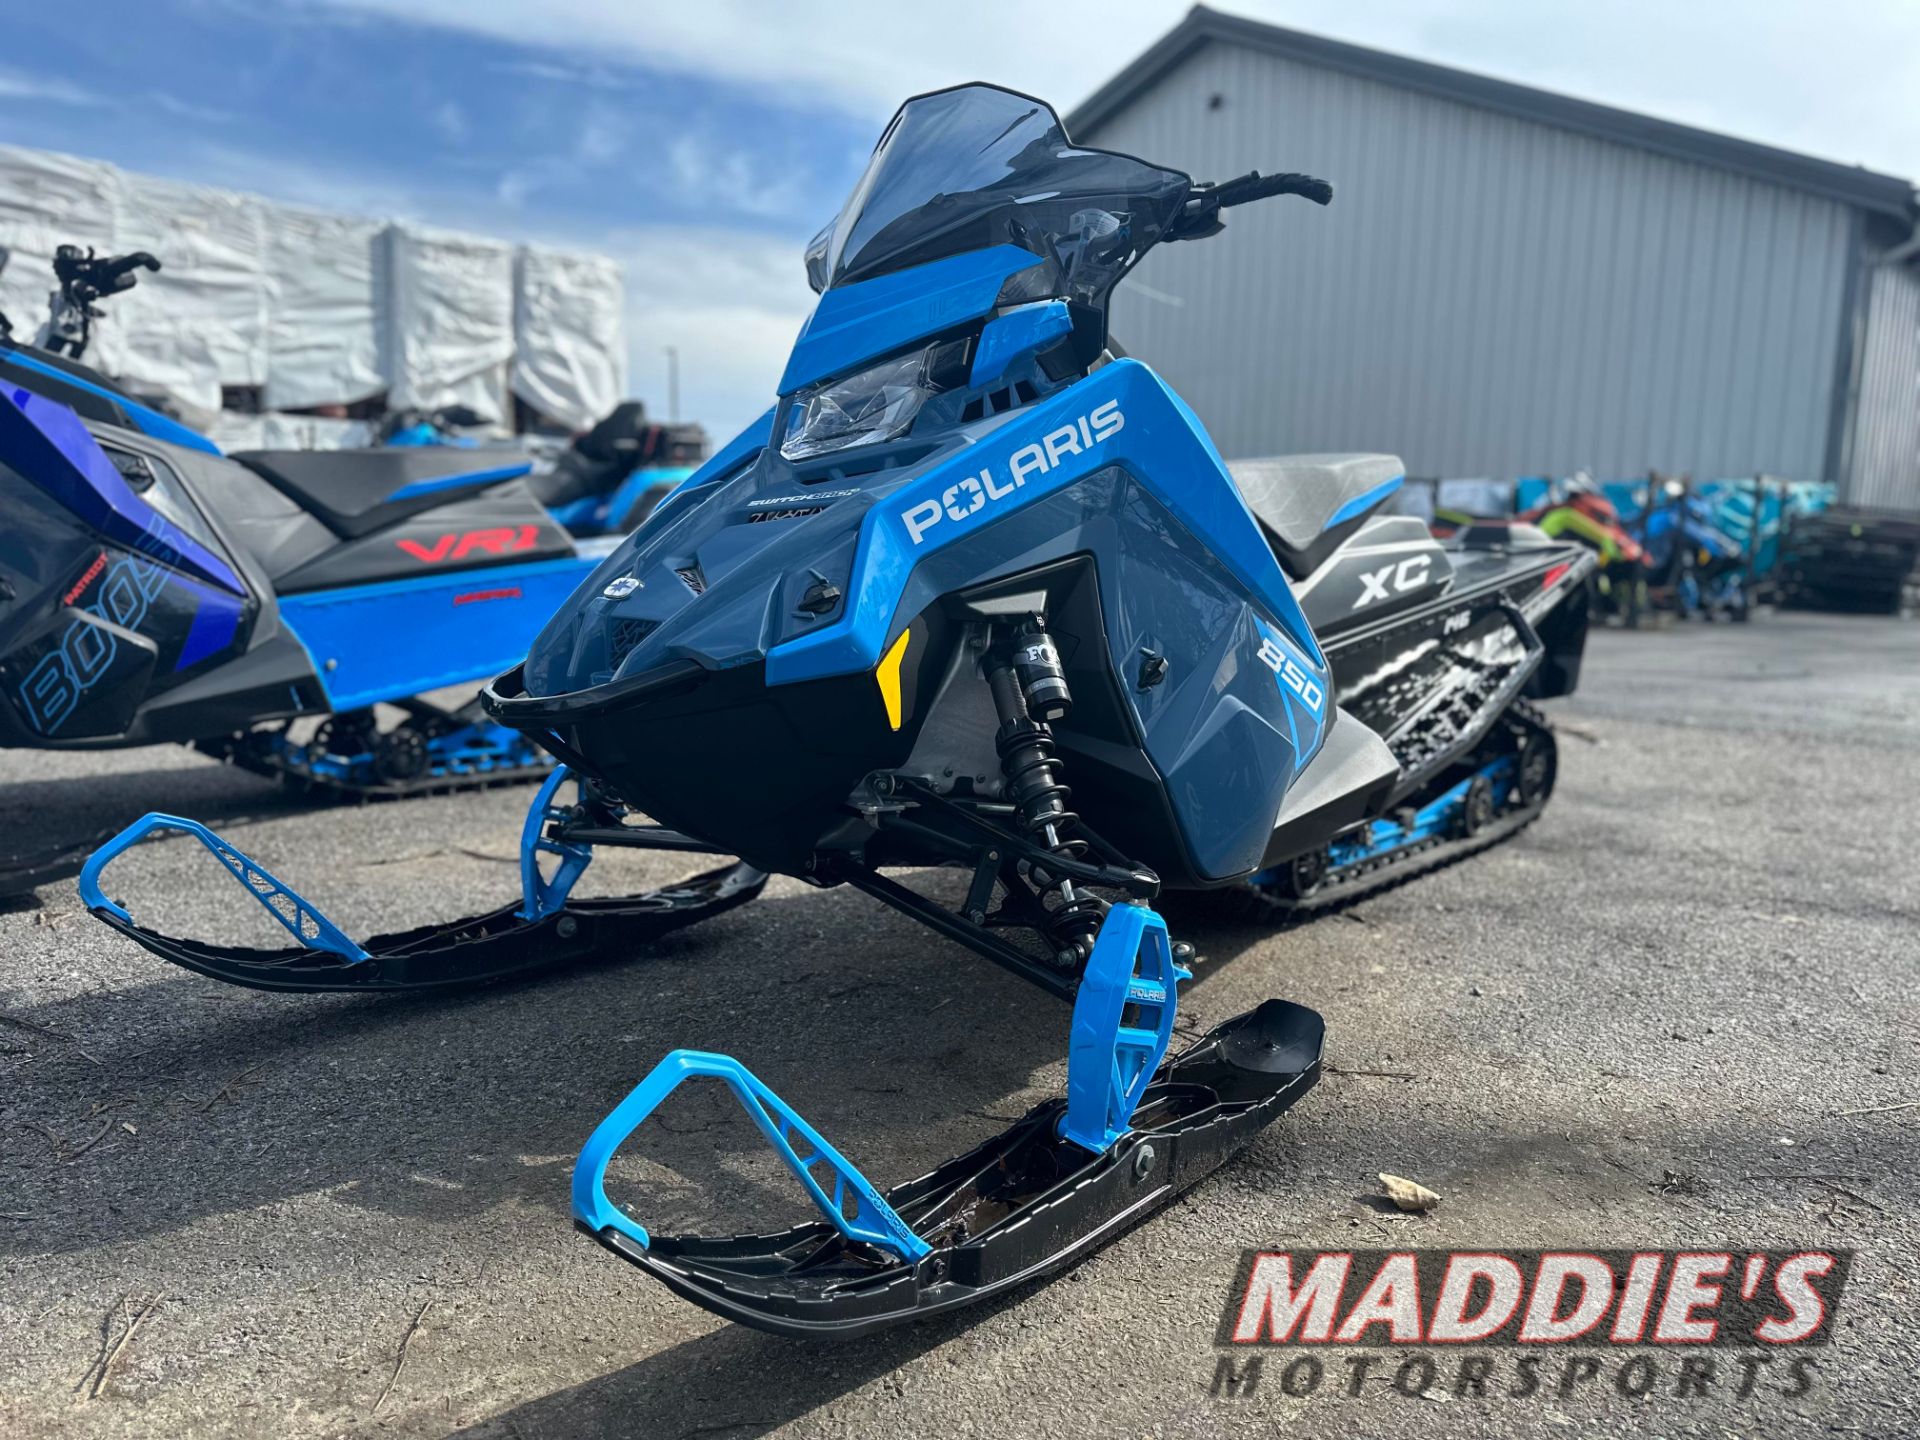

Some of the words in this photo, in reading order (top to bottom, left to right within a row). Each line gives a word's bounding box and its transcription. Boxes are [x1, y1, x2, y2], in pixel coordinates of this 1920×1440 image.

[901, 399, 1125, 545] POLARIS
[395, 524, 539, 564] VR1
[1352, 553, 1432, 610] XC
[1256, 637, 1323, 713] 850
[1130, 986, 1166, 1001] POLARIS
[868, 1188, 910, 1240] POLARIS
